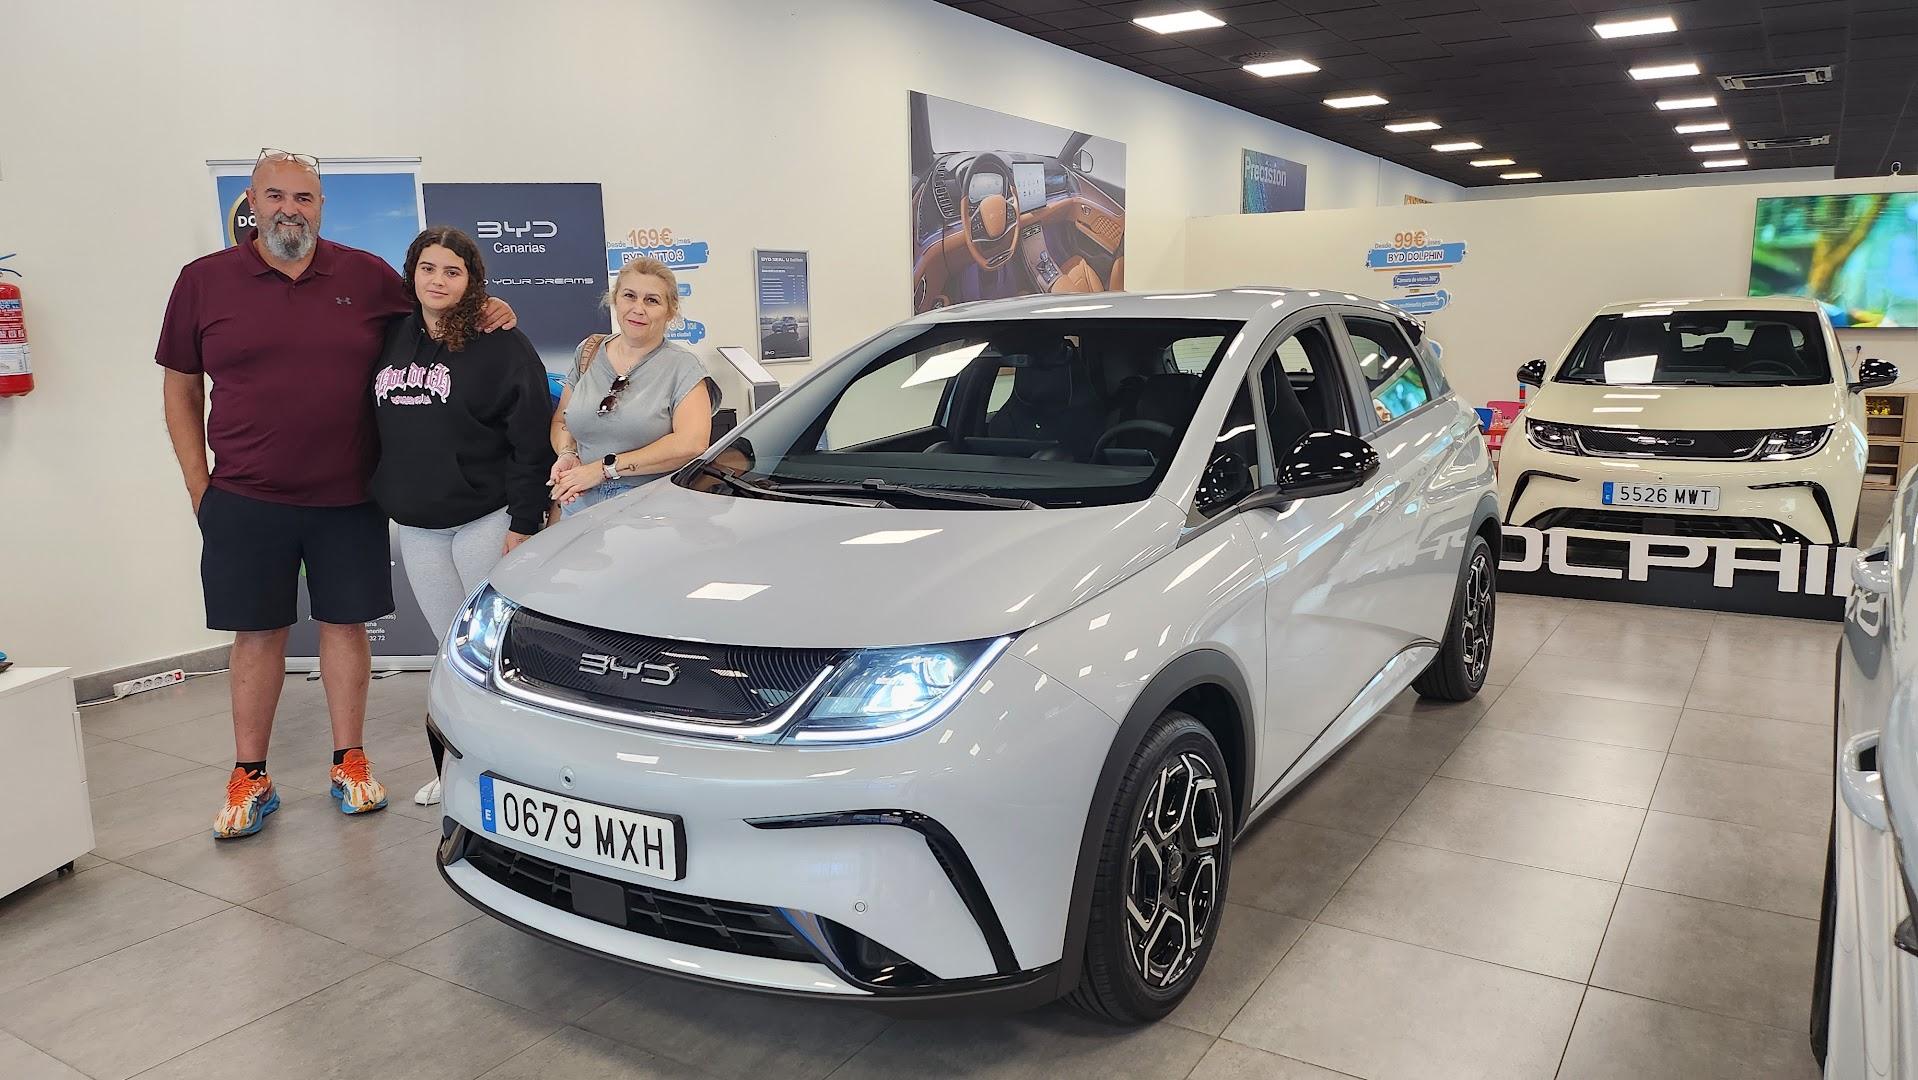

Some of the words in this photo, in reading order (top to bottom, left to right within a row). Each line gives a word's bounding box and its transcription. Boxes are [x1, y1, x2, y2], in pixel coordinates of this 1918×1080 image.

[1244, 156, 1287, 187] Precision
[477, 221, 558, 238] BYD
[628, 228, 673, 248] 169€
[493, 242, 546, 253] Canarias
[1394, 231, 1425, 248] 99€
[1388, 253, 1405, 262] BYD
[1407, 251, 1443, 261] DOLPHIN
[535, 277, 594, 285] DREAMS
[1620, 486, 1668, 503] 5526
[1674, 489, 1711, 505] MWT
[1498, 526, 1861, 598] OLPHI
[579, 652, 680, 686] BYD
[485, 809, 492, 821] E
[503, 792, 581, 849] 0679
[594, 814, 664, 870] MXH
